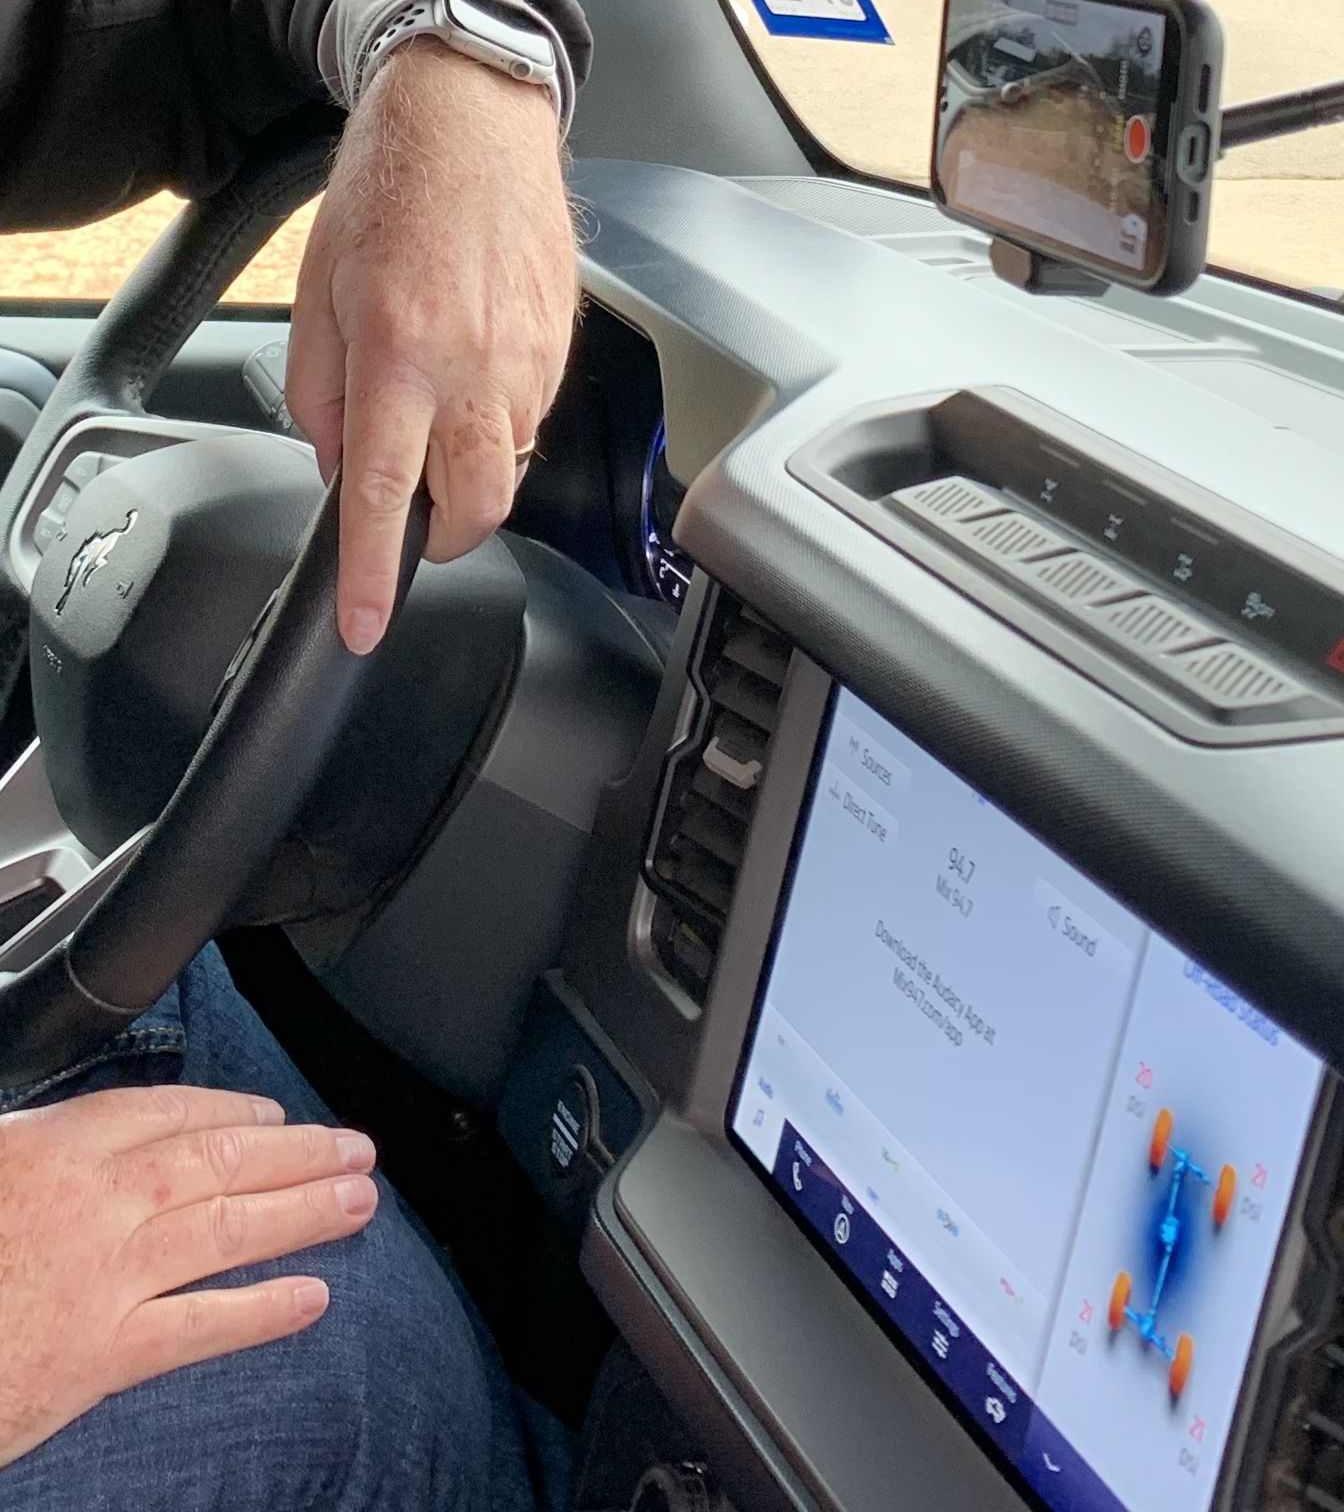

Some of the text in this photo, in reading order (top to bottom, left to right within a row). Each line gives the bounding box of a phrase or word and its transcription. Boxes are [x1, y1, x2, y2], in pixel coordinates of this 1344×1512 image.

[861, 748, 893, 786] Sources
[867, 811, 887, 842] Tune
[948, 847, 976, 885] 94.7
[1062, 916, 1098, 957] Sound
[916, 960, 933, 986] the
[1135, 1061, 1153, 1089] 20
[1250, 1161, 1269, 1191] 21
